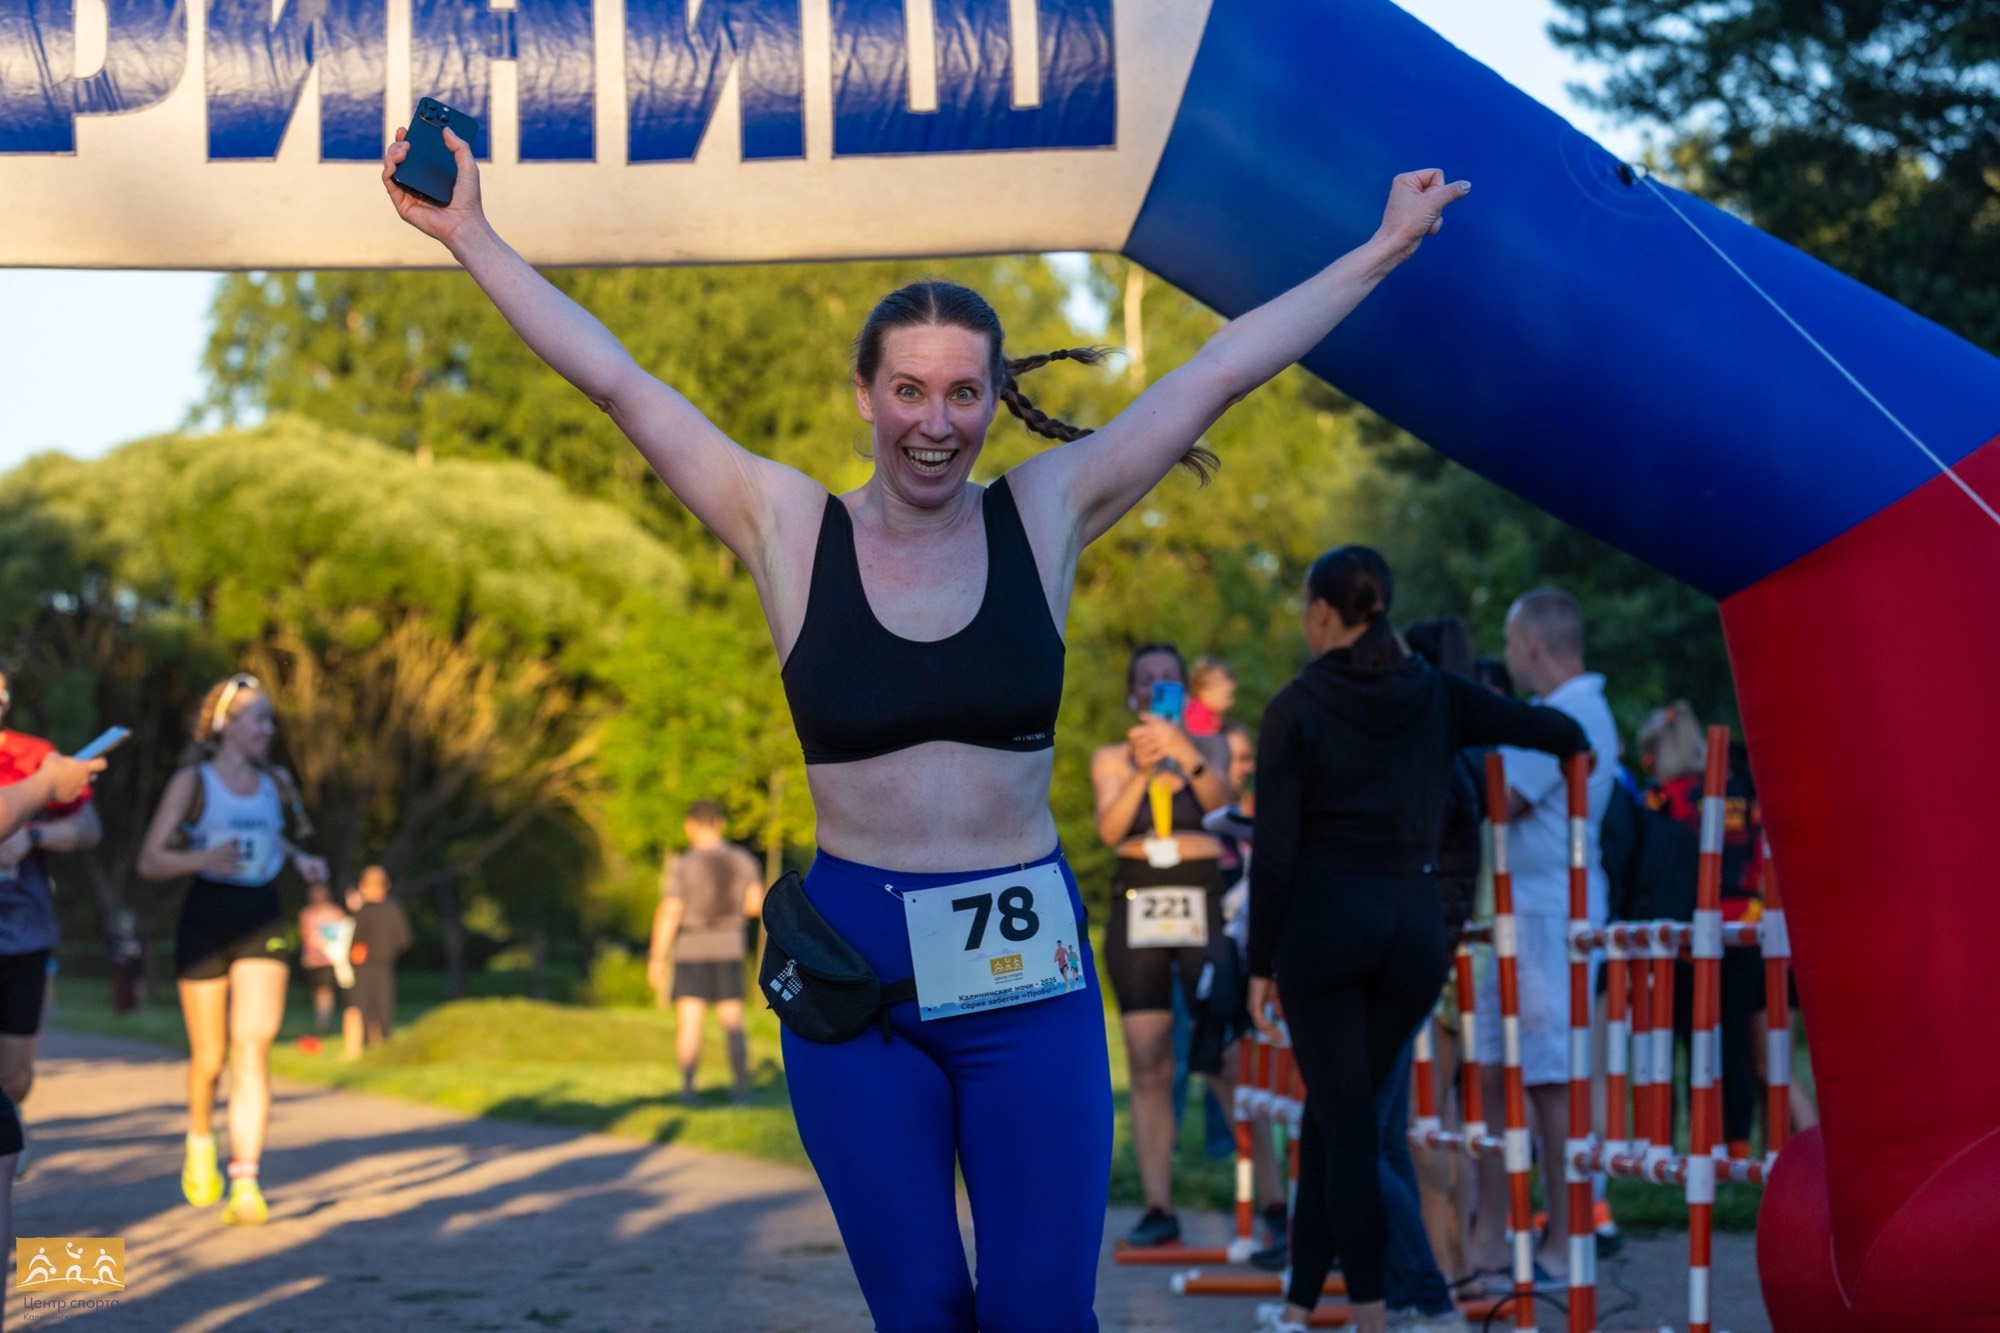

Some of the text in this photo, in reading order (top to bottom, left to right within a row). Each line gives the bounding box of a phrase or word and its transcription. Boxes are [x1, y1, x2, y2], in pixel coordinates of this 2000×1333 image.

[952, 886, 1040, 951] 78
[1143, 896, 1192, 920] 221
[958, 987, 1013, 1002] Калининские
[1014, 983, 1034, 991] ночи
[960, 1001, 987, 1010] Серия
[987, 994, 1020, 1006] забегов
